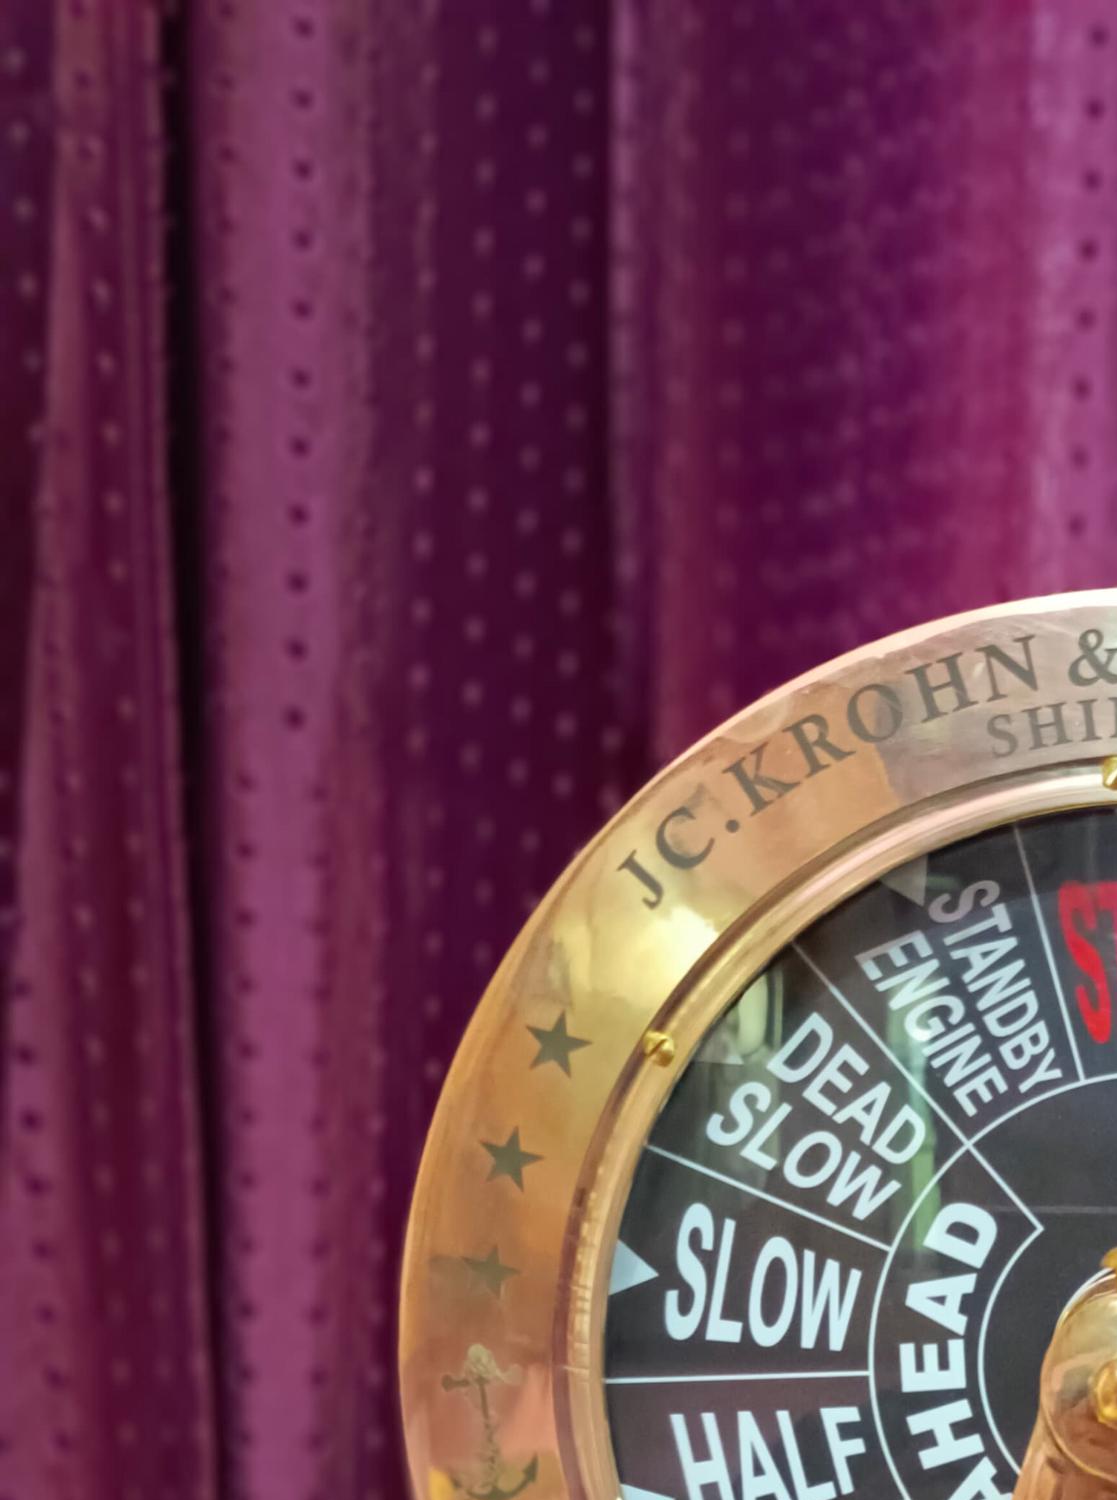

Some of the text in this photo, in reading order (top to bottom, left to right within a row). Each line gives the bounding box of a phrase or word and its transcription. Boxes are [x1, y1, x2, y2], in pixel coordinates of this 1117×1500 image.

[854, 930, 1009, 1118] ENGINE
[928, 880, 1063, 1094] STANDBY
[705, 1082, 902, 1222] SLOW
[766, 1011, 926, 1165] DEAD
[664, 1203, 862, 1352] SLOW
